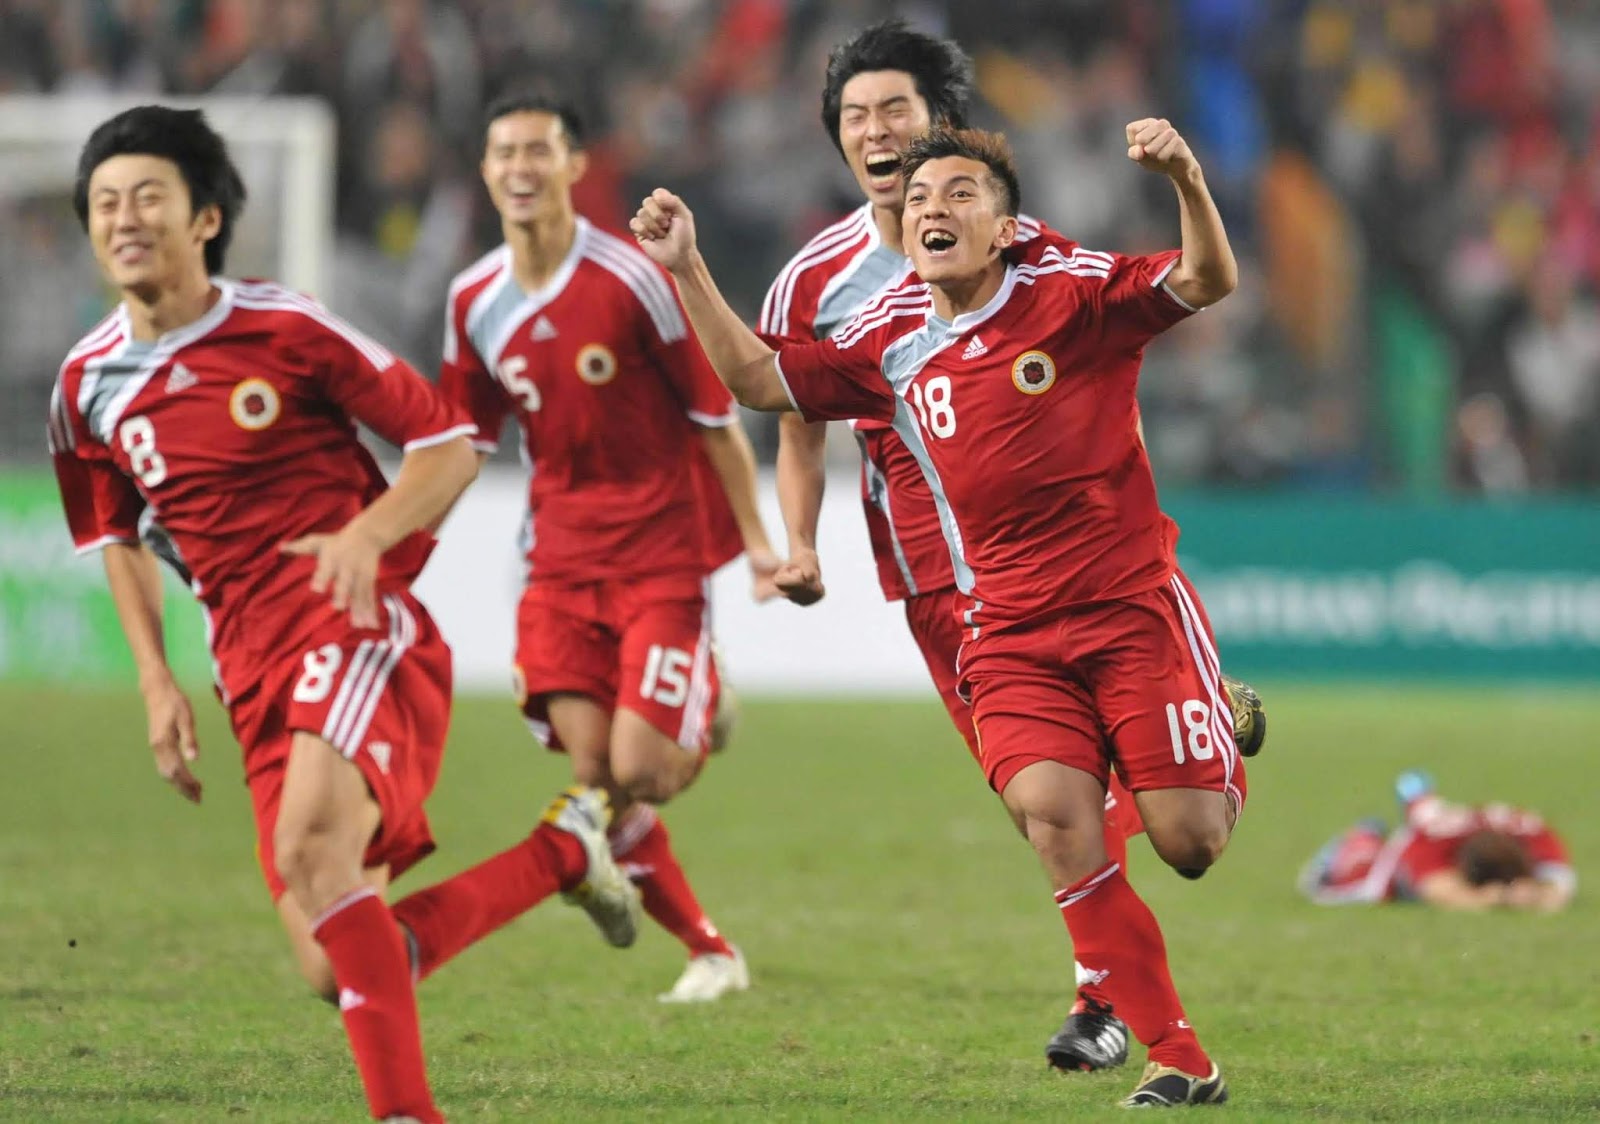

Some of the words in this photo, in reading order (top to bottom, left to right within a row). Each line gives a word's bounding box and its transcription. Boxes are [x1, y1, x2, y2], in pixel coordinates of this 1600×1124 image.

[961, 346, 989, 361] adidas
[912, 375, 957, 441] 18
[120, 414, 168, 488] 8
[293, 642, 342, 703] 8
[639, 644, 692, 707] 15
[1165, 699, 1214, 765] 18
